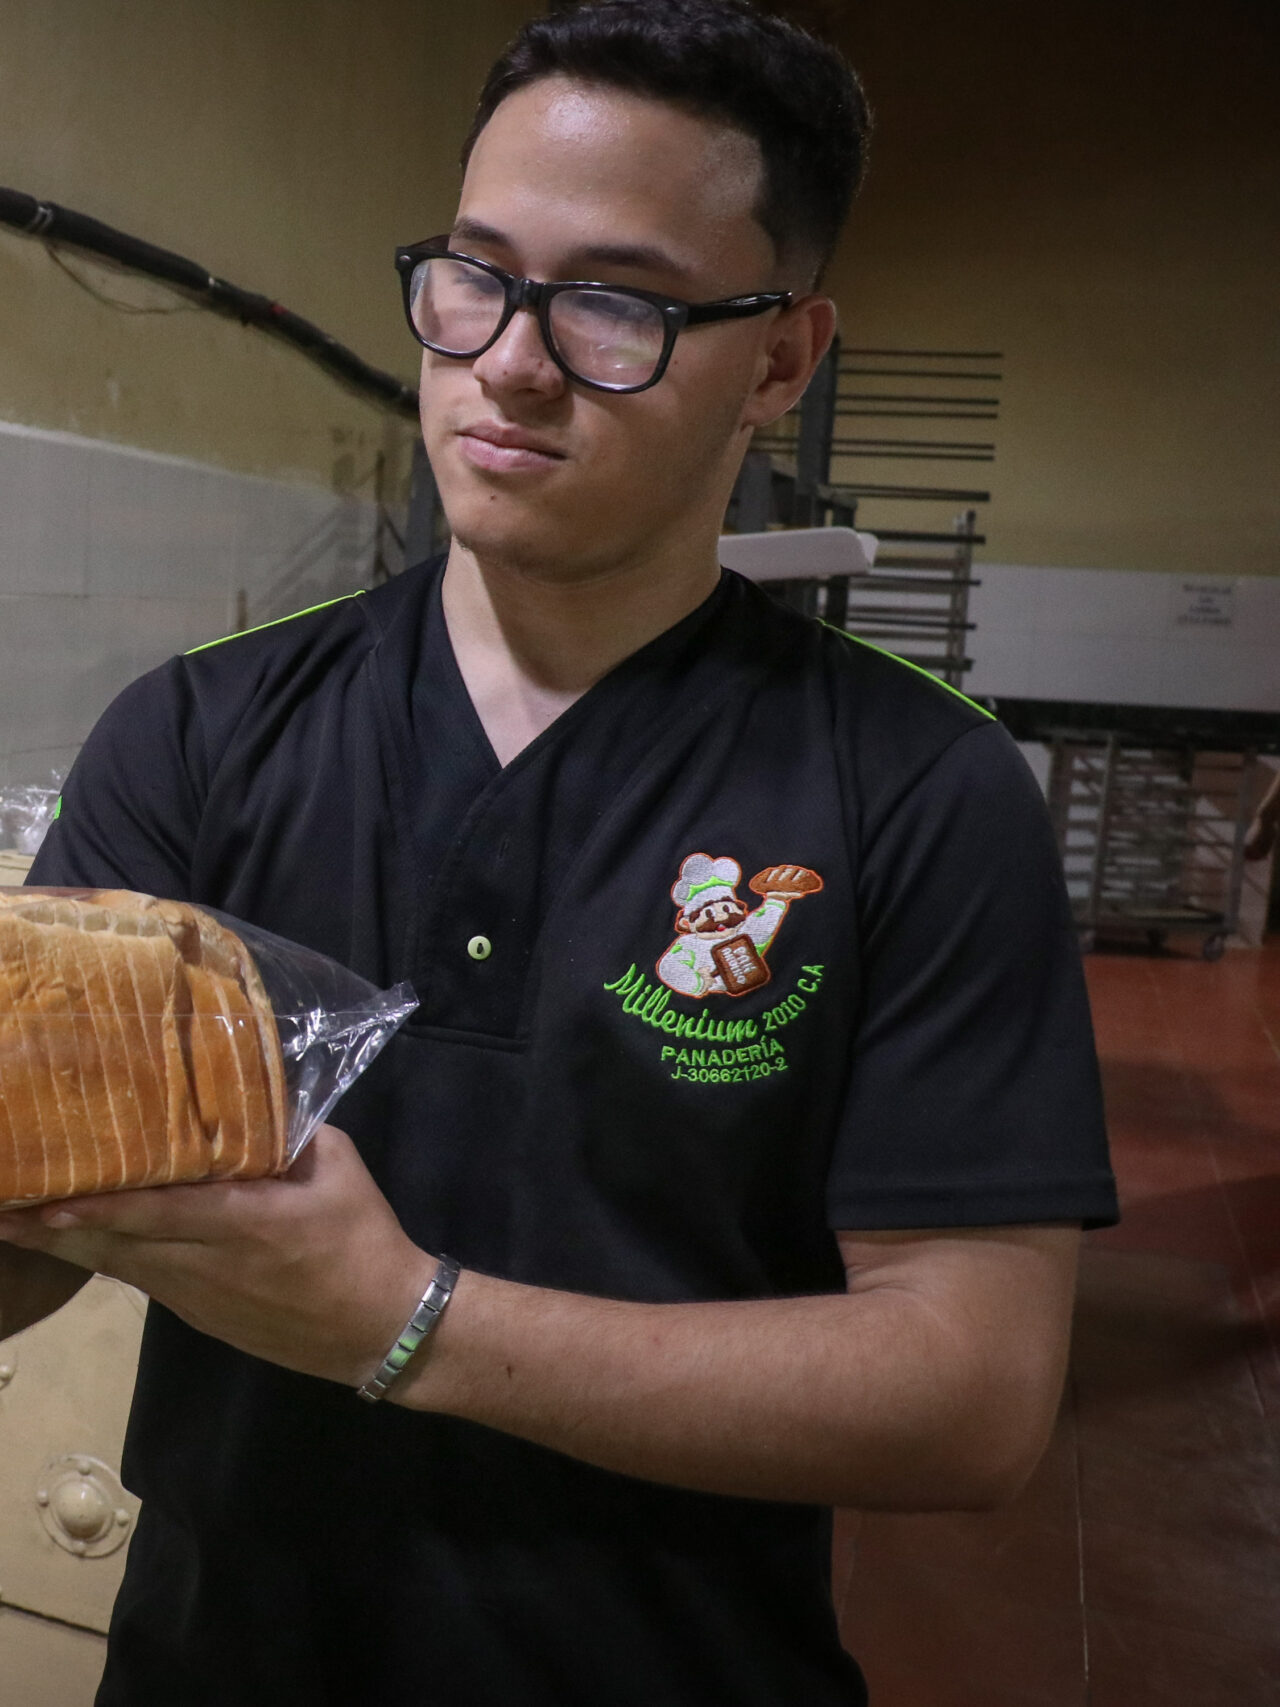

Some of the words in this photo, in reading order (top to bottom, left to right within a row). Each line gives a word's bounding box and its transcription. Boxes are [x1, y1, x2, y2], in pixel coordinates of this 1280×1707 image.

[604, 963, 758, 1042] Millenium
[762, 994, 806, 1031] 2010
[661, 1035, 784, 1066] PANADERÍA
[671, 1056, 789, 1083] J-30662120-2
